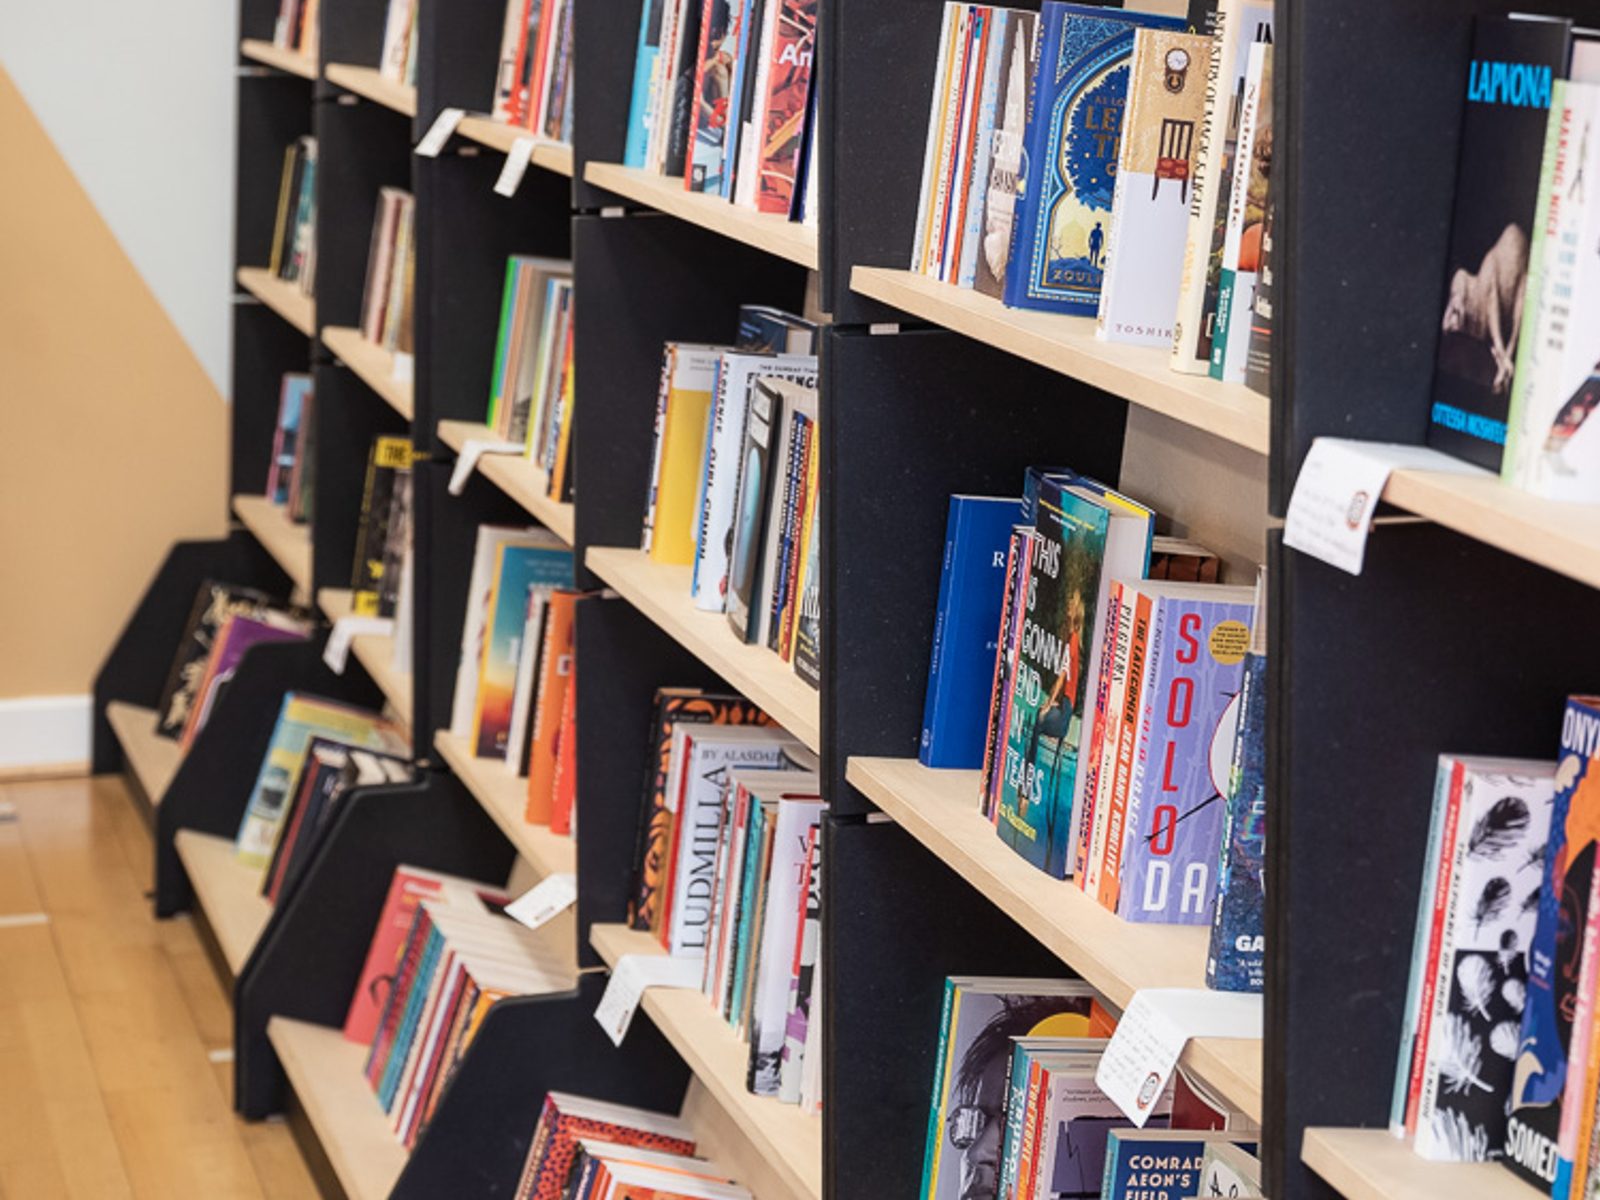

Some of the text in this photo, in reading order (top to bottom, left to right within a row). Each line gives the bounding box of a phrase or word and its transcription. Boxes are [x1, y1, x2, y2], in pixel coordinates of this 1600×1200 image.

[1467, 60, 1552, 109] LAPVONA
[1552, 108, 1572, 186] MAKING
[1033, 532, 1062, 579] THIS
[1021, 618, 1072, 682] GONNA
[1112, 603, 1132, 684] PILGRIMS
[1135, 618, 1147, 641] THE
[1015, 660, 1042, 708] END
[1124, 645, 1144, 723] LATECOMER
[1119, 725, 1134, 761] JEAN
[1005, 745, 1046, 806] TEARS
[681, 765, 727, 948] LUDMILLA
[1126, 1173, 1192, 1188] AEON'S
